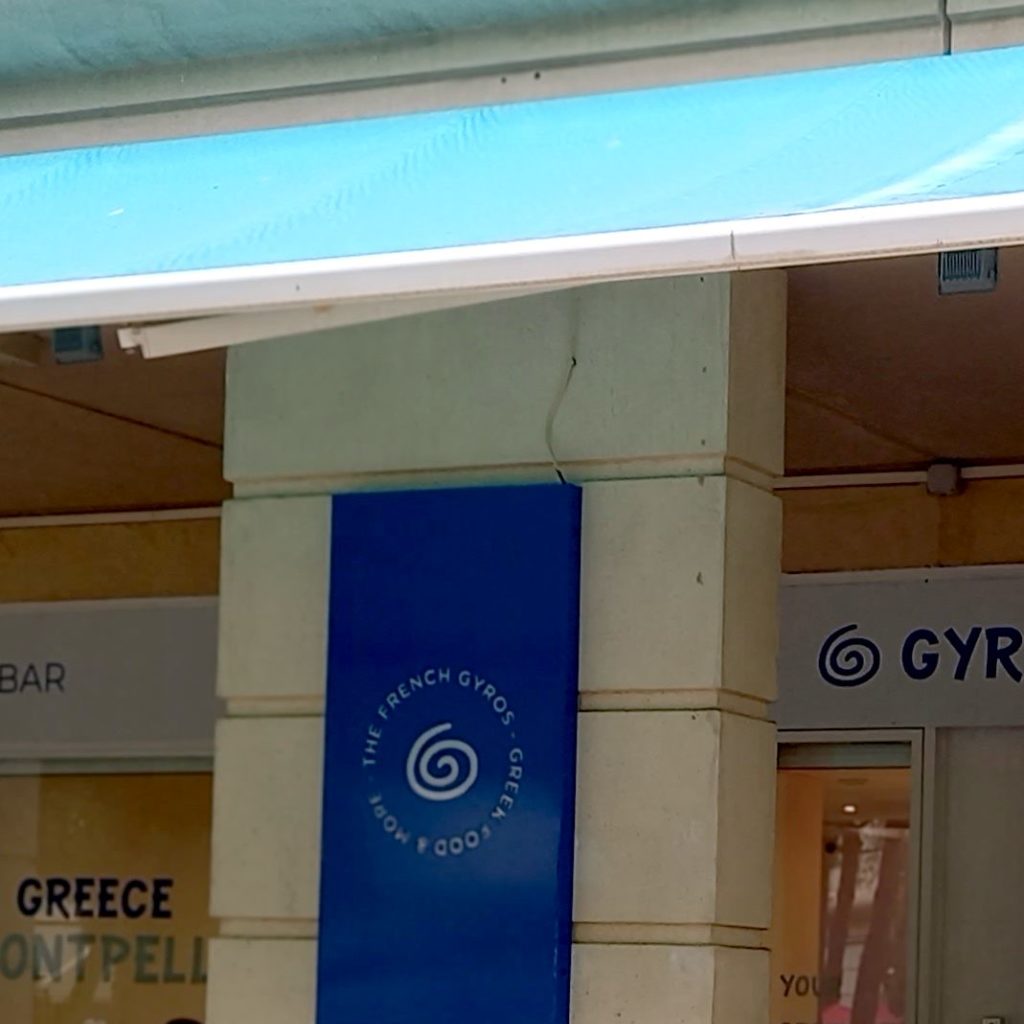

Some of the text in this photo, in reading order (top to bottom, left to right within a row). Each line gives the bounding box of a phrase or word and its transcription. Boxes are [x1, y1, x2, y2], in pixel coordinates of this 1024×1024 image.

[362, 724, 382, 768] THE
[378, 668, 451, 721] FRENCH
[458, 670, 516, 726] GYROS
[490, 748, 524, 820] GREEK
[17, 877, 174, 919] GREECE
